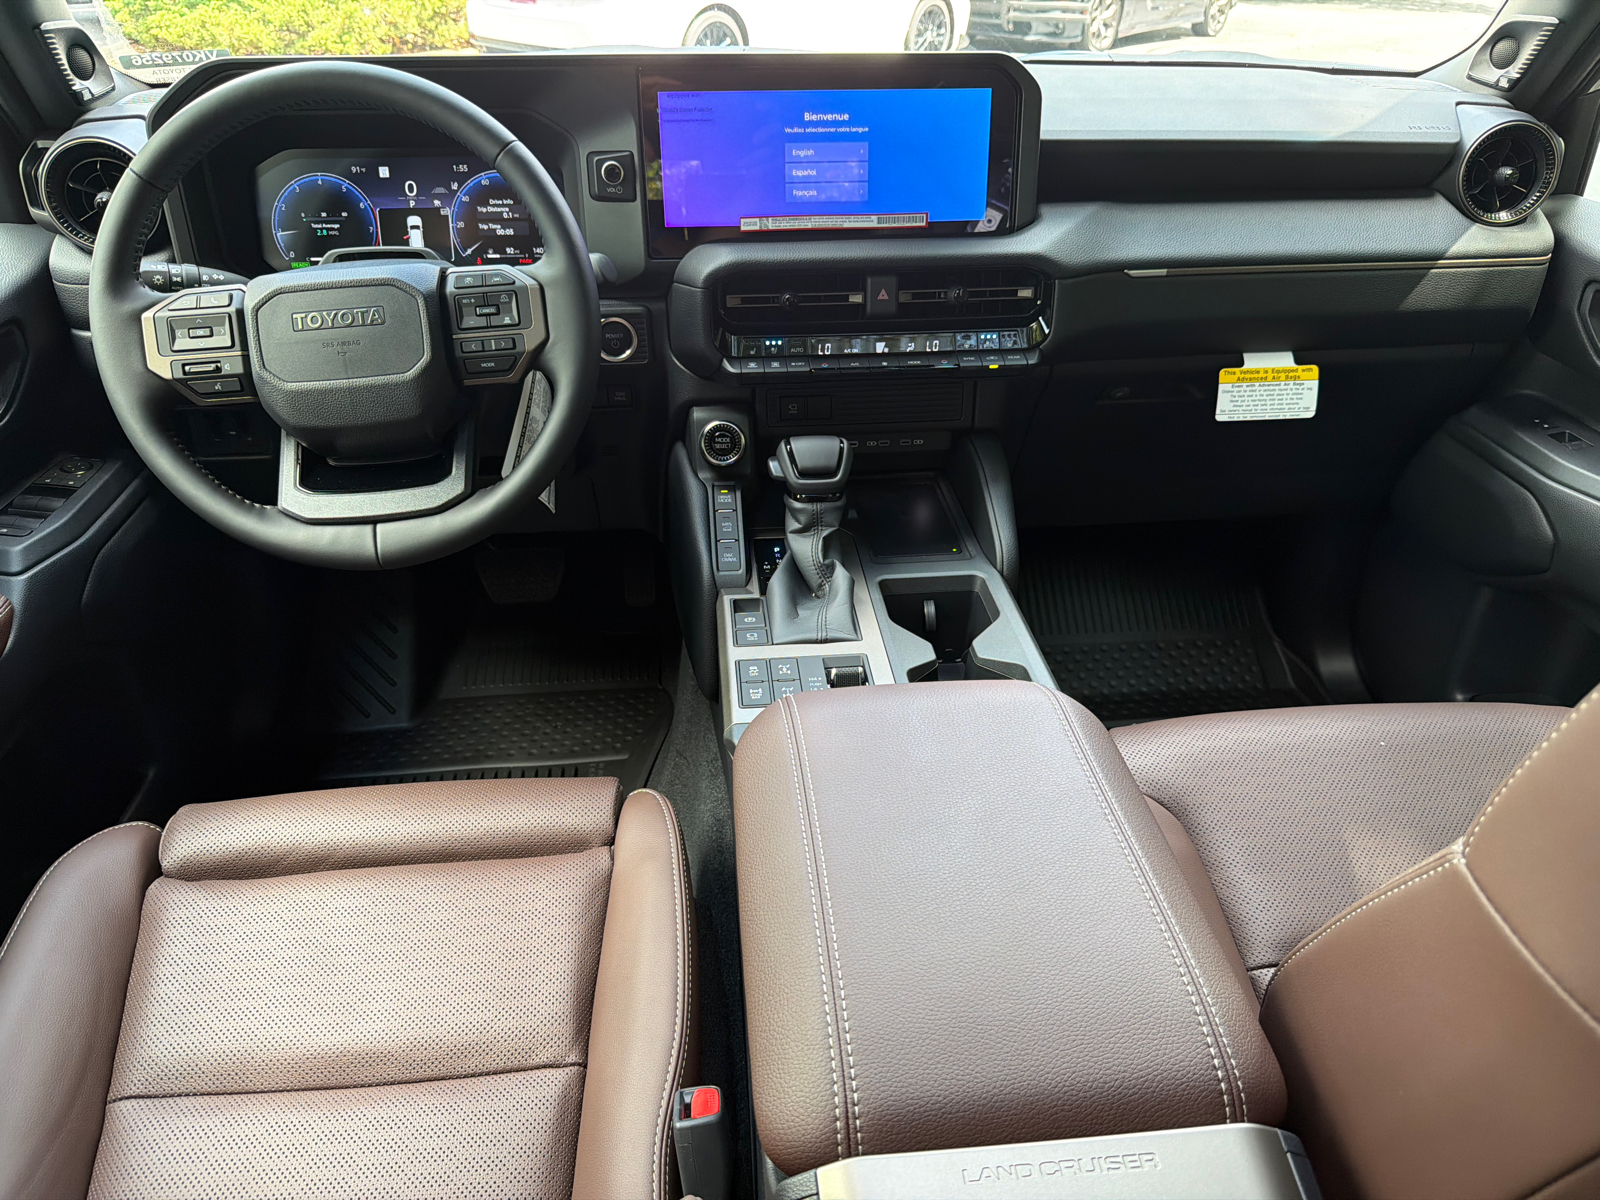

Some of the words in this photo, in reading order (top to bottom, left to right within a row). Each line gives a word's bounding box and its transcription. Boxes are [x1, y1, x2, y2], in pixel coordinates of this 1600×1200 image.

[804, 112, 850, 121] Bienvenue
[792, 149, 815, 158] English
[792, 169, 816, 178] Español
[404, 180, 418, 196] 0
[792, 188, 818, 197] Français
[292, 307, 384, 330] TOYOTA
[336, 339, 362, 348] AIRBAG
[961, 1163, 1034, 1185] LAND
[1038, 1152, 1162, 1178] CRUISER
